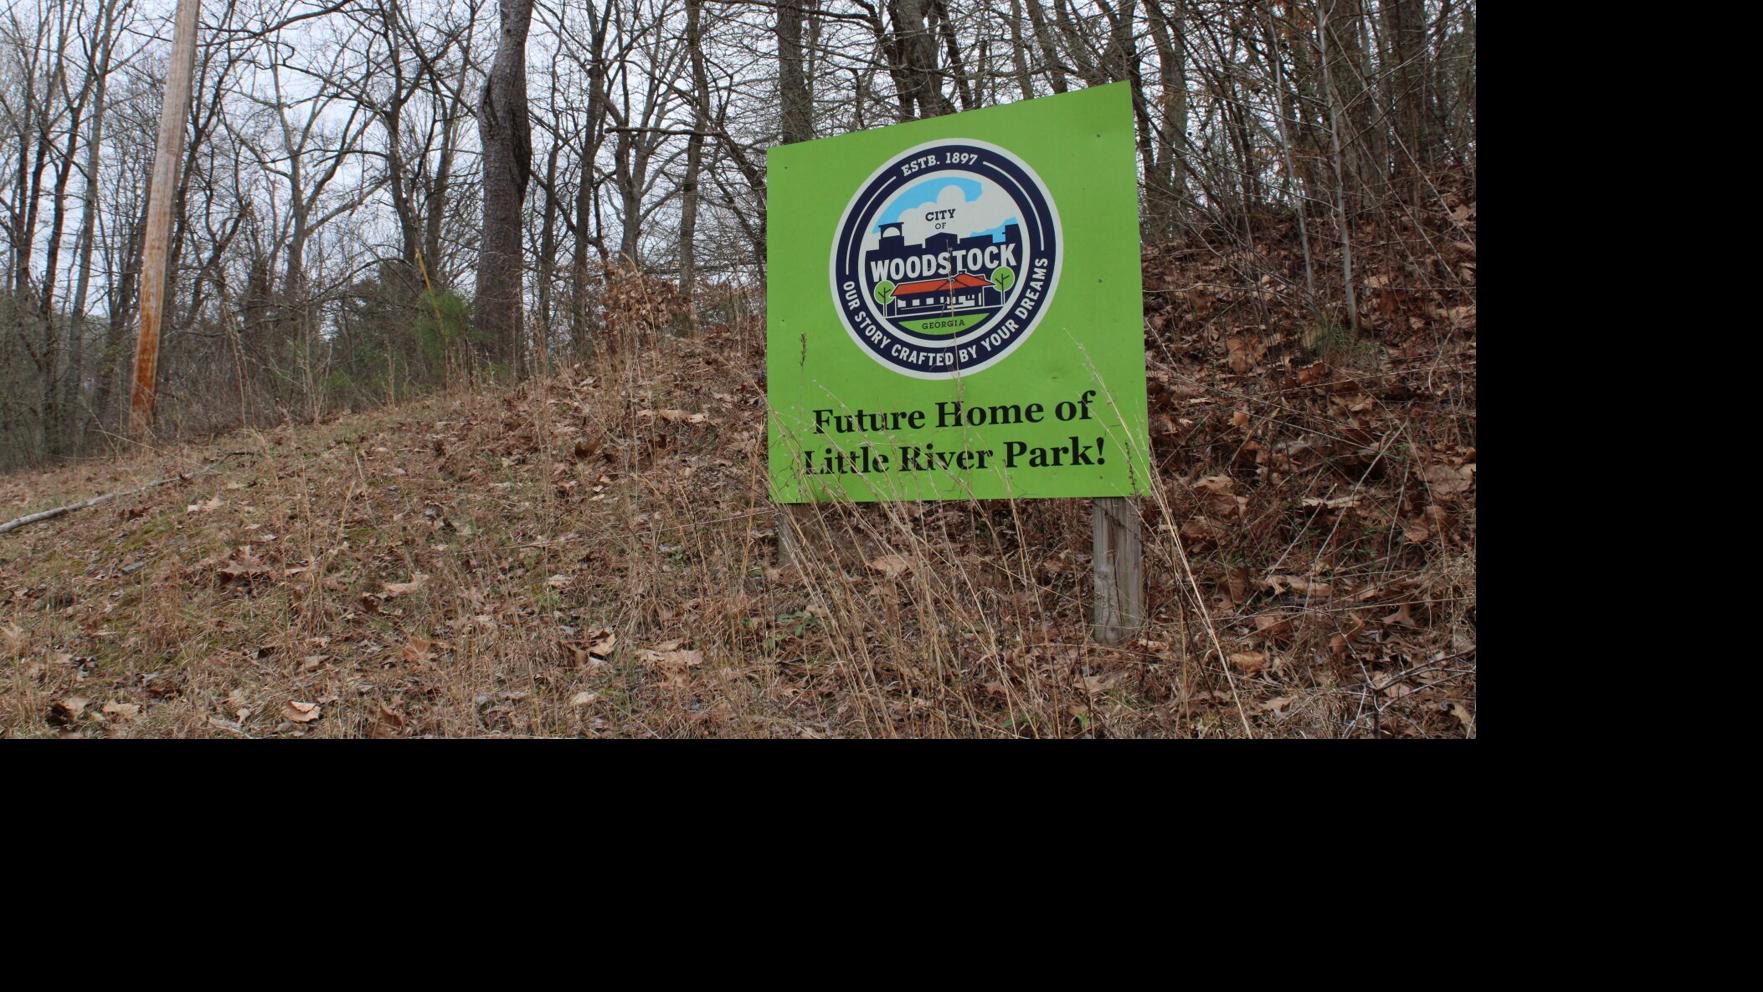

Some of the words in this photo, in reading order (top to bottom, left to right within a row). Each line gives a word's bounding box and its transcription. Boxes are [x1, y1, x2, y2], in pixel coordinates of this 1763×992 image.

[901, 154, 940, 177] ESTB.
[945, 152, 978, 166] 1897
[925, 208, 956, 222] CITY
[934, 222, 946, 230] OF
[871, 243, 1017, 282] WOODSTOCK
[843, 280, 861, 311] OUR
[854, 311, 891, 350] STORY
[891, 343, 954, 366] CRAFTED
[959, 345, 978, 363] BY
[981, 319, 1020, 352] YOUR
[1014, 258, 1048, 320] DREAMS
[921, 319, 966, 331] GEORGIA
[812, 408, 925, 434] Future
[935, 400, 1044, 428] Home
[1054, 390, 1097, 422] of
[804, 446, 889, 475] Little
[898, 443, 993, 472] River
[1003, 436, 1106, 468] Park!
